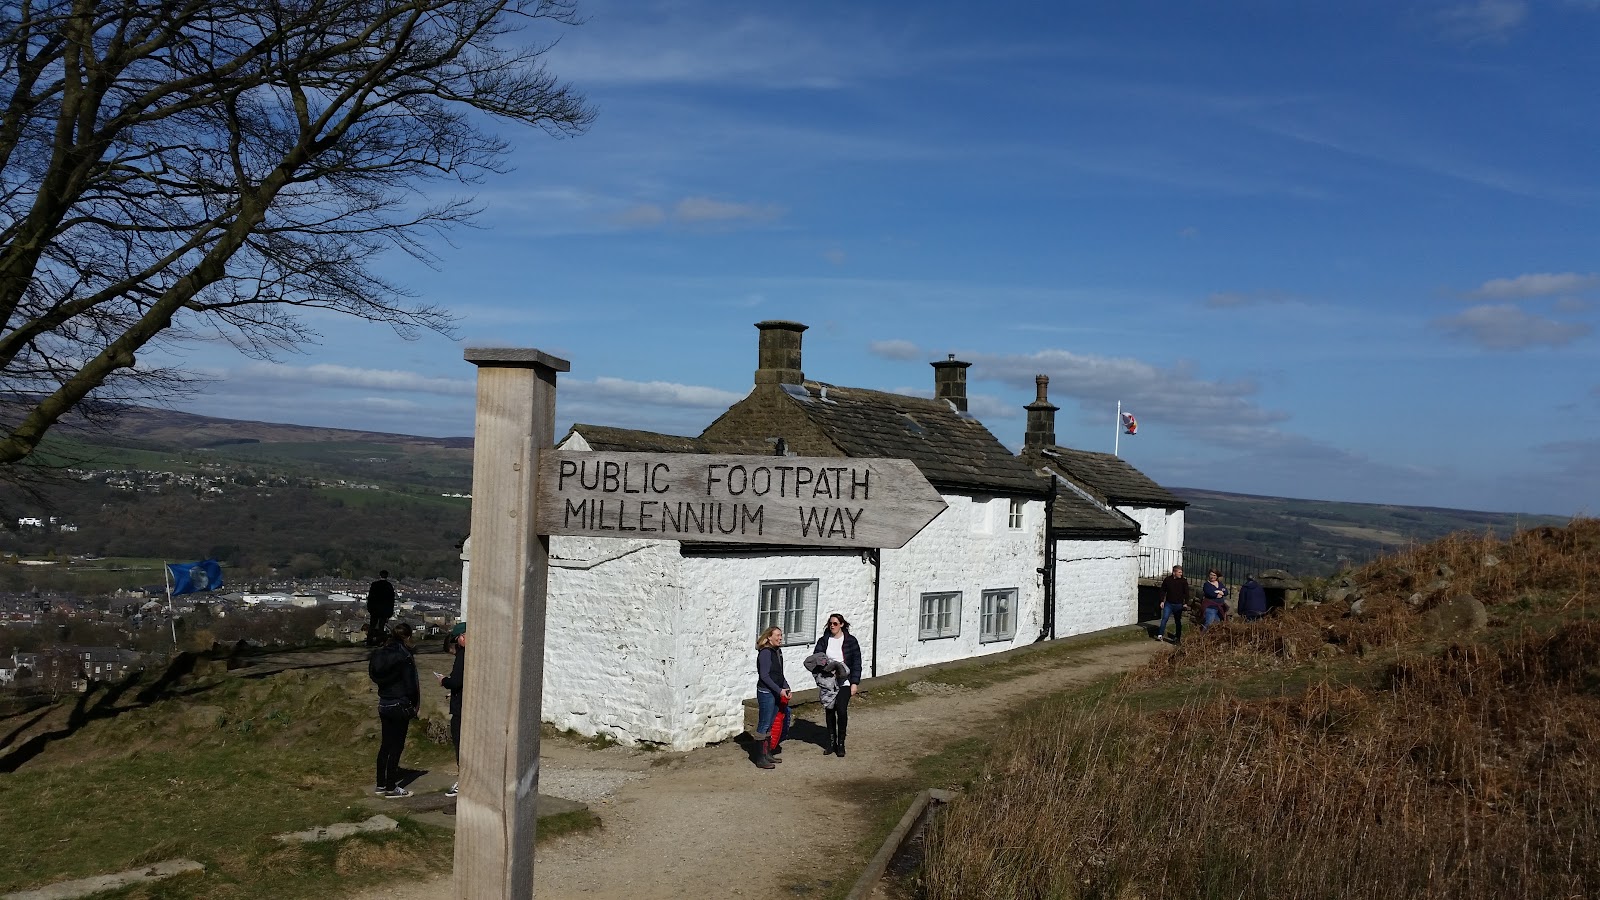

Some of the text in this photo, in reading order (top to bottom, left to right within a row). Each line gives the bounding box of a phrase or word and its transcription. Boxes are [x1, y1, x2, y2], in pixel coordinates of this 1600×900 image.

[558, 460, 870, 500] PUBLIC FOOTPATH
[564, 498, 864, 539] MILLENNIUM WAY
